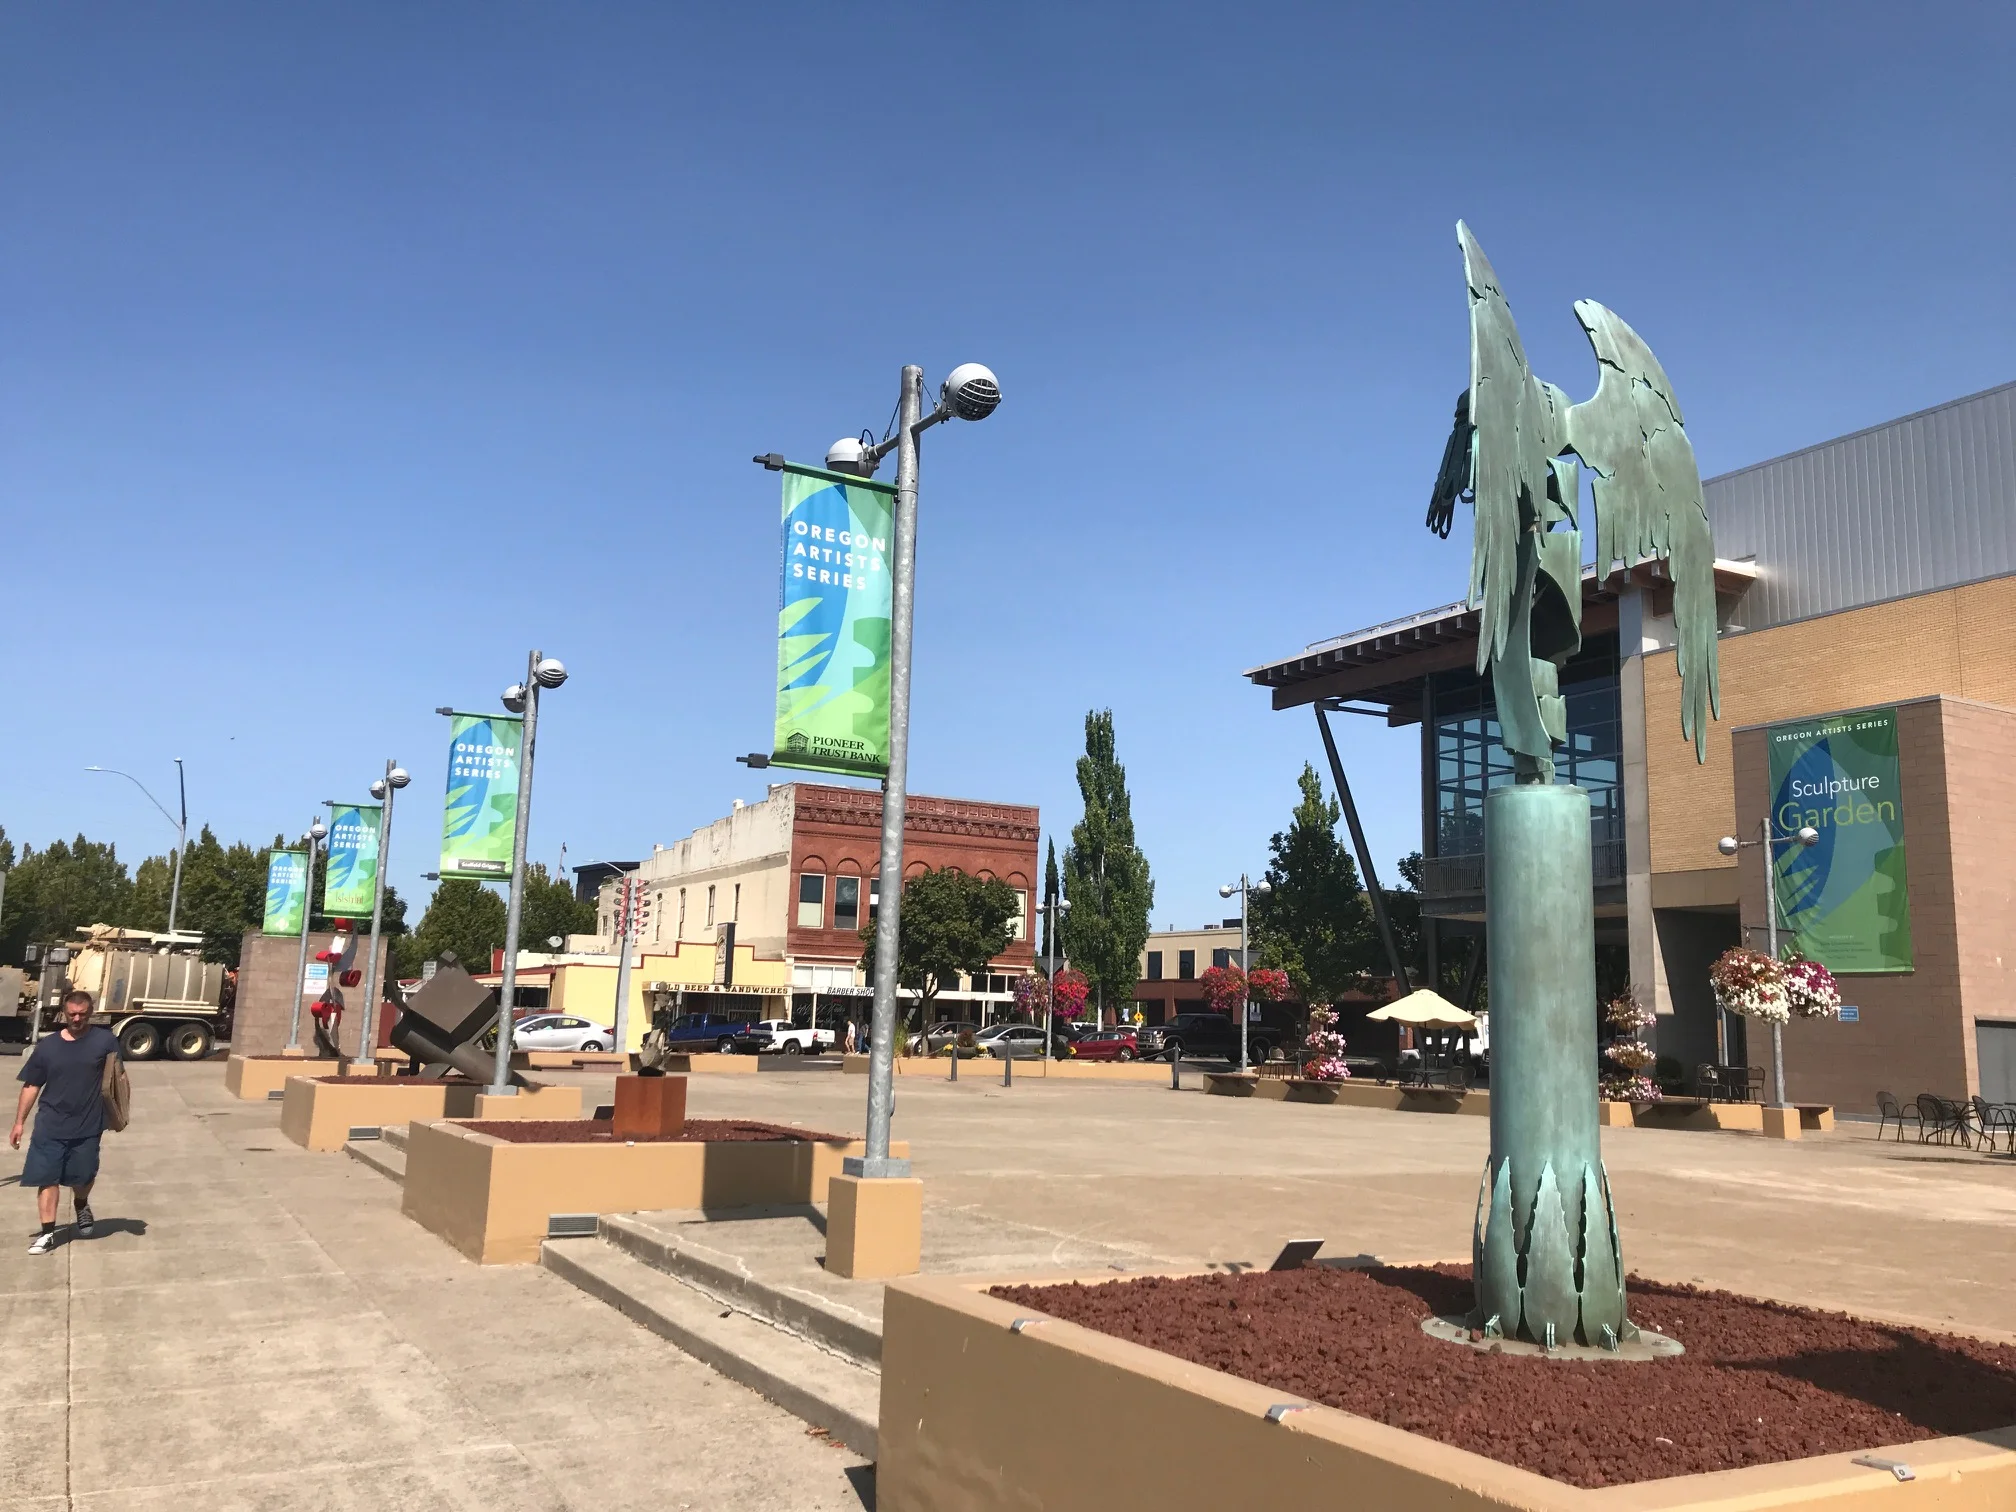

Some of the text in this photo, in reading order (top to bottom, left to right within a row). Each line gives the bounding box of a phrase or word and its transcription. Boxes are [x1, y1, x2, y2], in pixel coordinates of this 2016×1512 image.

[794, 521, 885, 552] OREGON
[793, 542, 881, 572] ARTISTS
[793, 563, 866, 590] SERIES
[1776, 719, 1888, 742] OREGON ARTISTS SERIES
[456, 743, 515, 757] OREGON
[813, 736, 864, 751] PIONEER
[455, 755, 511, 768] ARTISTS
[812, 746, 881, 763] TRUST BANK
[454, 767, 501, 779] SERIES
[1792, 775, 1880, 800] Sculpture
[1778, 794, 1895, 832] Garden
[335, 824, 376, 834] OREGON
[334, 833, 373, 842] ARTISTS
[333, 841, 367, 849] SERIES
[655, 983, 680, 991] CLD
[684, 984, 710, 992] BEER
[827, 986, 875, 997] BARBER SHOP
